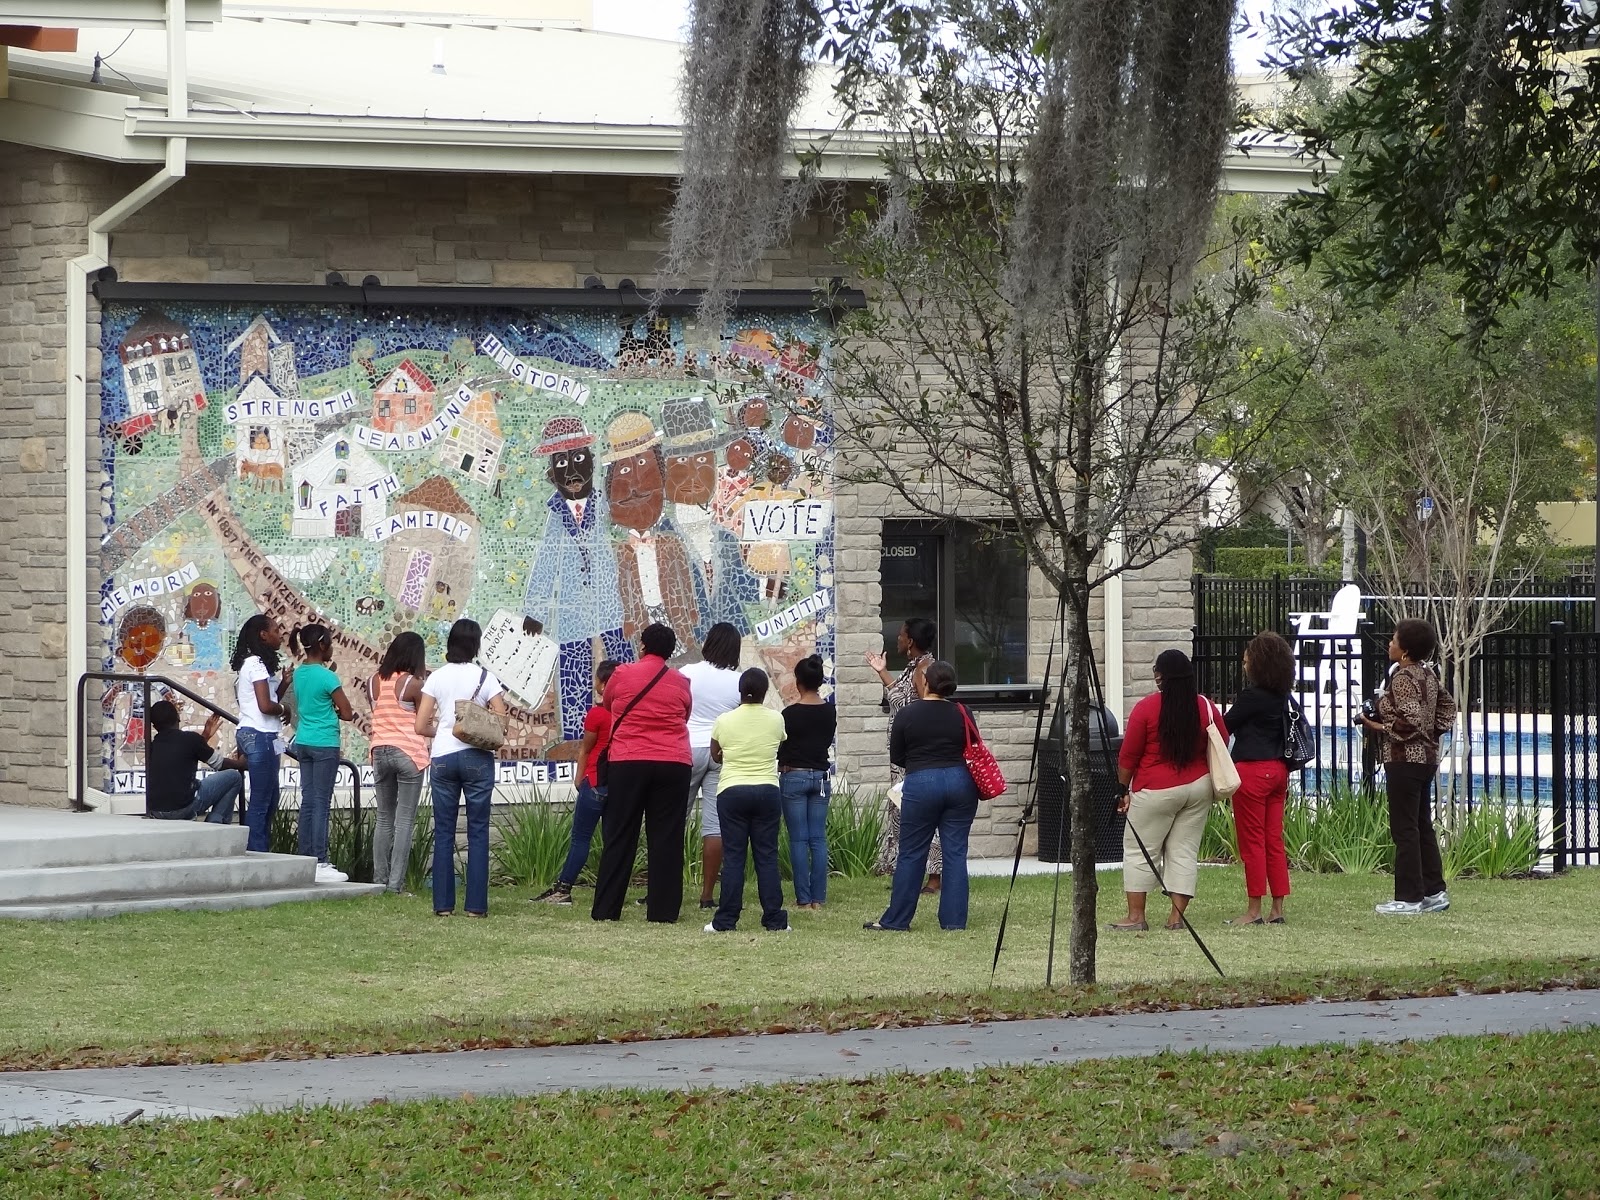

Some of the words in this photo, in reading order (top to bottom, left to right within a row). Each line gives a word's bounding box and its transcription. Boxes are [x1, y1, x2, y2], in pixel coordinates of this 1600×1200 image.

[482, 338, 588, 403] HISTORY
[227, 390, 355, 422] STRENGTH
[357, 389, 470, 449] LEARNING
[319, 475, 397, 517] FAITH
[375, 512, 469, 540] FAMILY
[749, 504, 822, 535] VOTE
[206, 500, 220, 516] IN
[217, 516, 239, 543] 1887
[239, 541, 262, 567] THE
[262, 566, 307, 615] CITIZENS
[880, 546, 917, 557] CLOSED
[100, 564, 196, 620] MEMORY
[262, 591, 286, 616] AND
[483, 624, 498, 641] THE
[757, 591, 828, 638] UNITY
[485, 617, 512, 660] ADVOCATE
